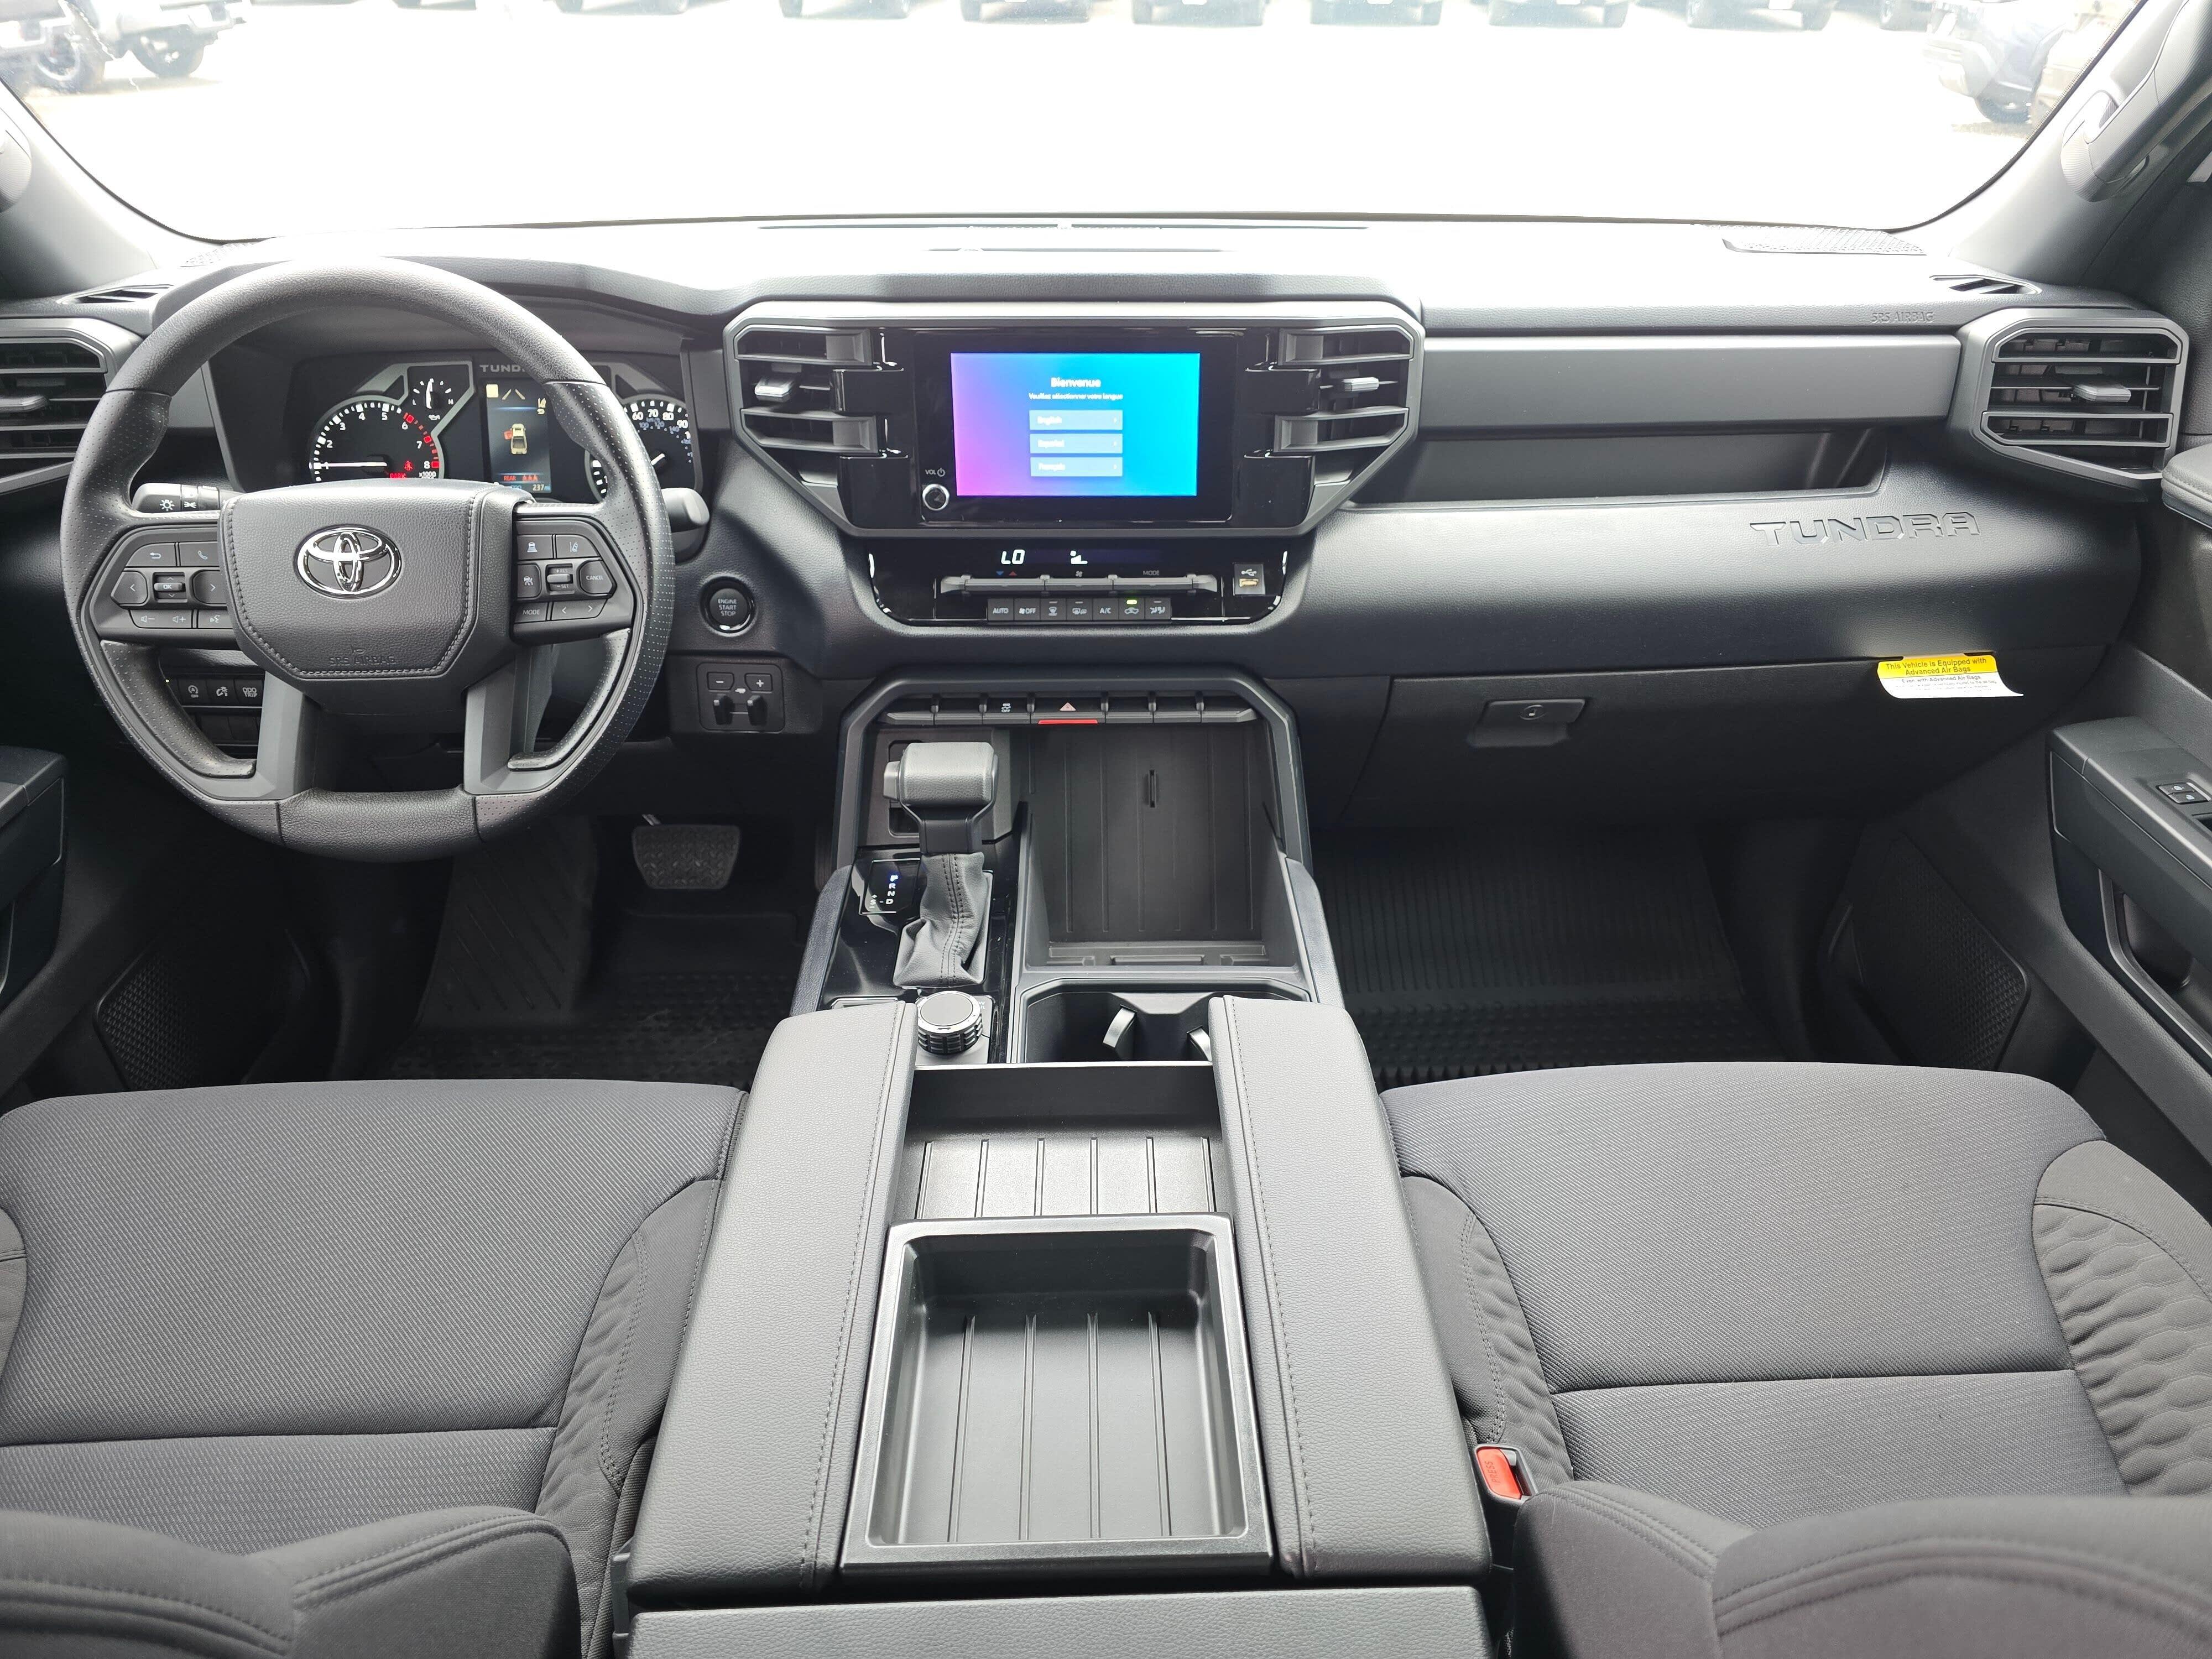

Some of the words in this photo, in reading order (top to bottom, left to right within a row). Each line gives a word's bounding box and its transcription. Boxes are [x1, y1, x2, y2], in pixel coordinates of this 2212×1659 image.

[1871, 312, 1890, 323] SRS
[1893, 311, 1934, 323] AIRBAG
[1051, 377, 1101, 388] Bienvenue
[632, 411, 644, 420] 60
[648, 409, 659, 418] 70
[662, 412, 674, 421] 80
[339, 422, 346, 431] 3
[401, 421, 408, 430] 6
[676, 420, 688, 429] 90
[327, 440, 333, 448] 2
[416, 440, 422, 449] 7
[424, 461, 430, 469] 8
[1750, 511, 1981, 546] TUNDRA
[1001, 549, 1025, 565] LO
[1938, 659, 1970, 667] Equipped
[1906, 667, 1939, 675] Advanced
[1484, 1460, 1500, 1484] PRESS
